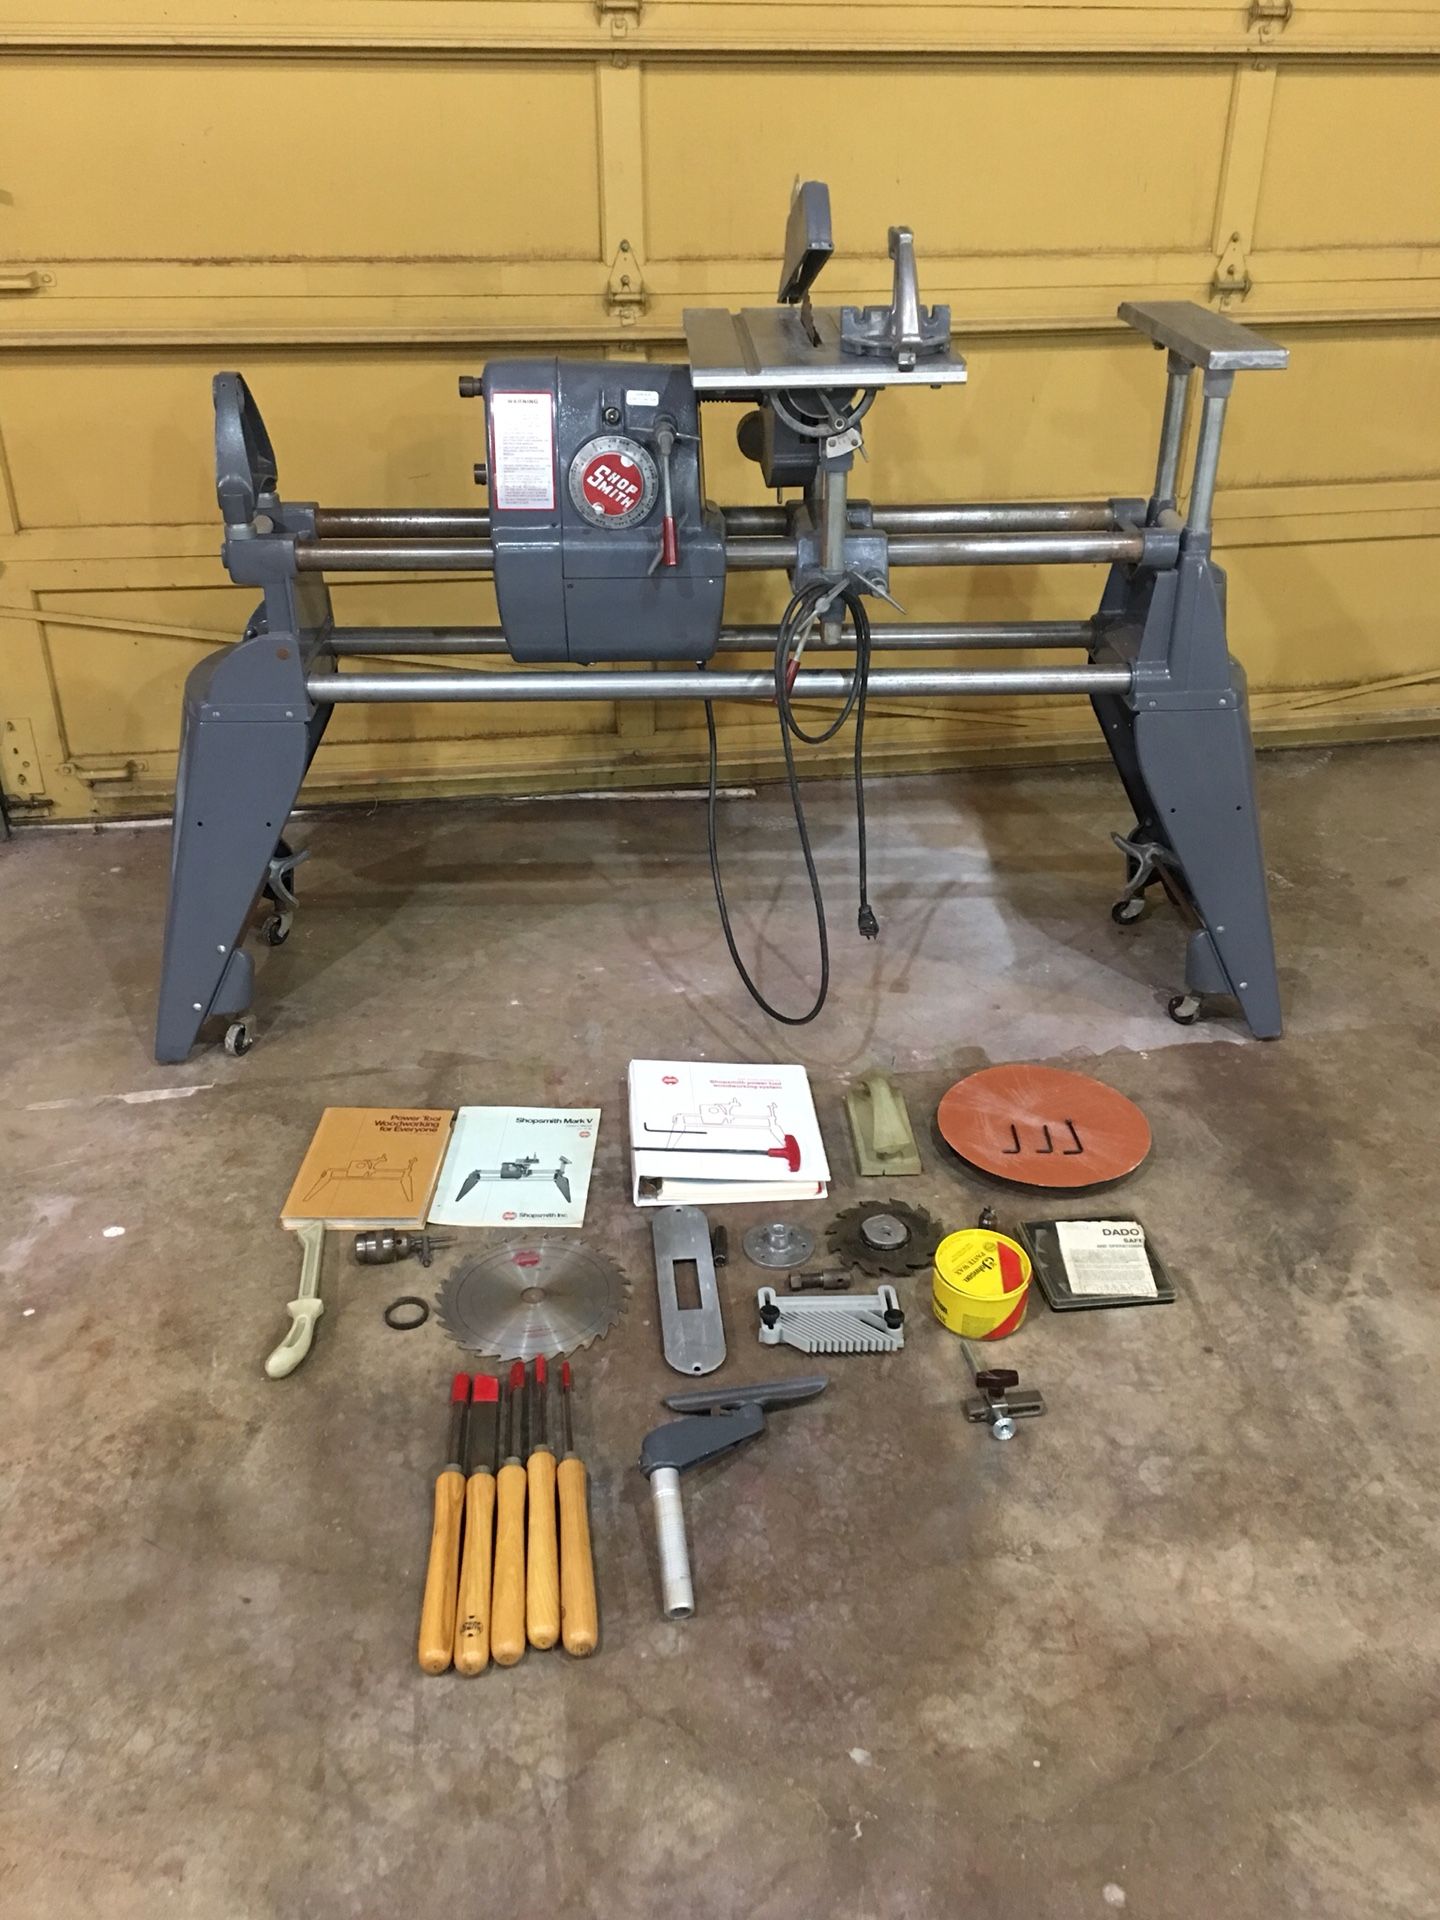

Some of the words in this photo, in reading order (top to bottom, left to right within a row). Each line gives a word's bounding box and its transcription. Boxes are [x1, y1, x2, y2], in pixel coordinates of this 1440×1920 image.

[375, 1120, 440, 1128] Woodworking
[516, 1117, 562, 1125] Shopsmith
[1102, 1228, 1140, 1236] DADO
